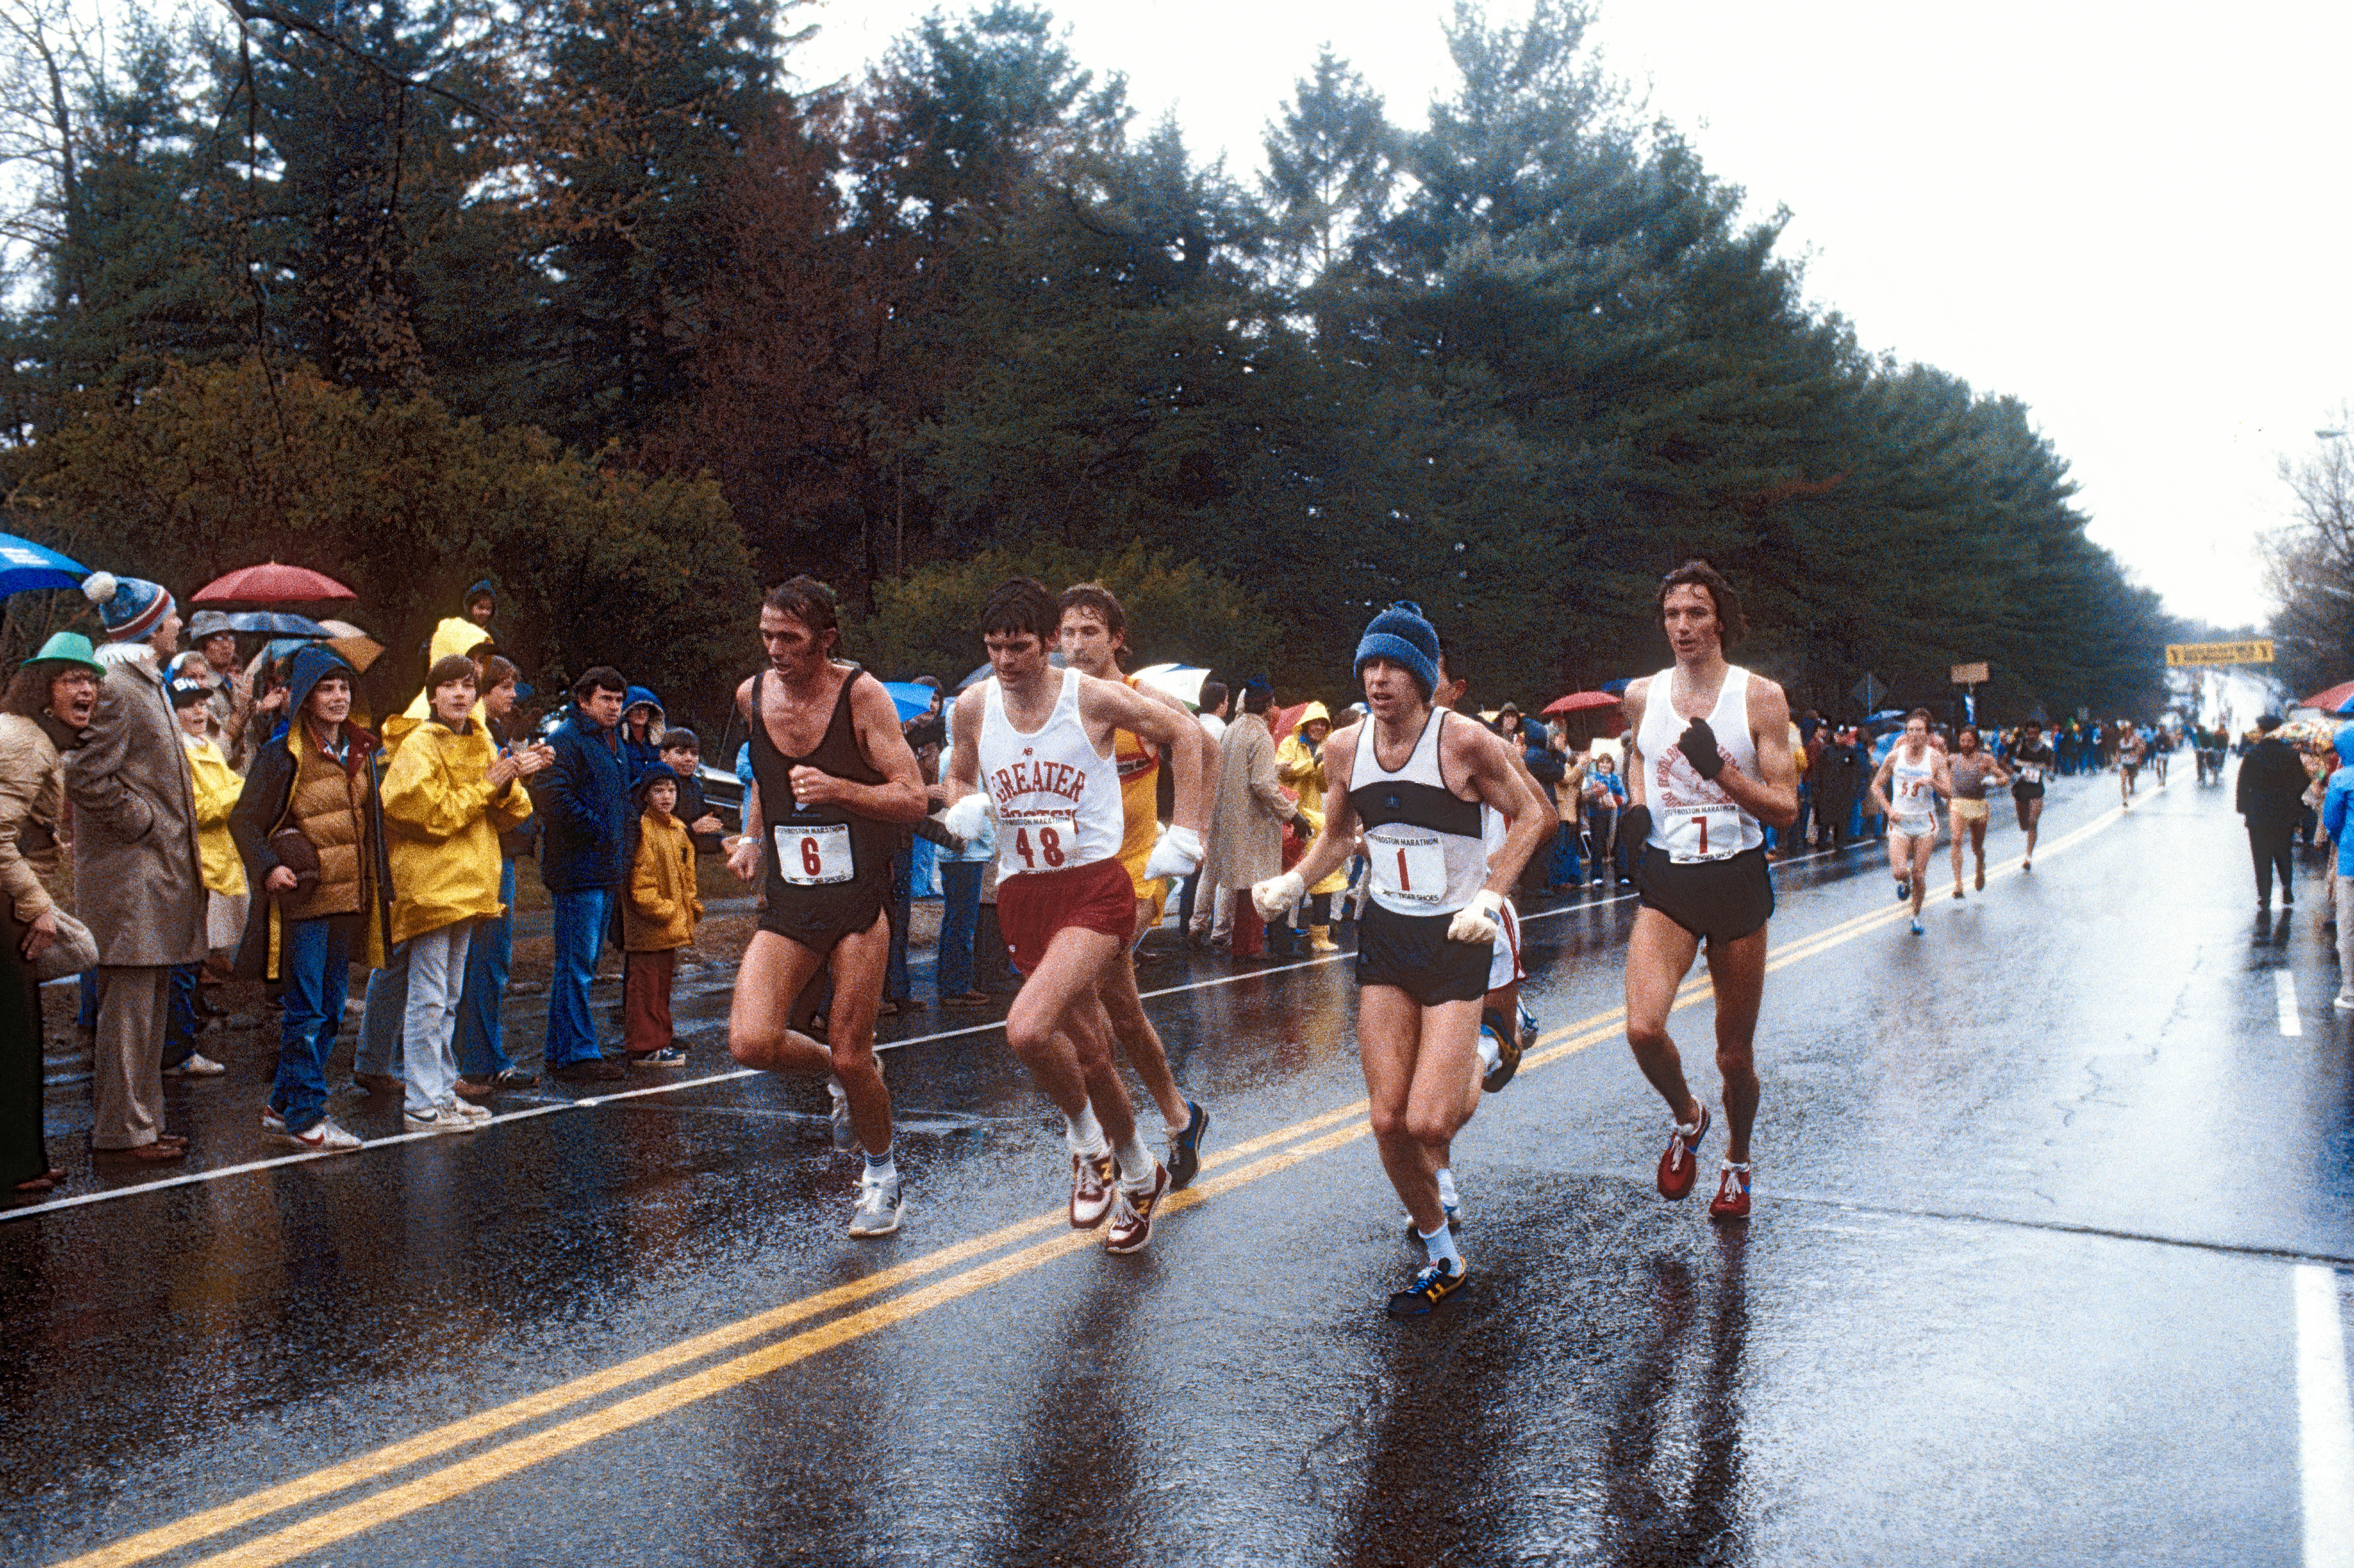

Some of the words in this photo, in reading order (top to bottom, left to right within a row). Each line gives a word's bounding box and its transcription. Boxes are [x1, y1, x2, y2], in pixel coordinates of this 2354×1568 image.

[1033, 817, 1070, 825] MARATHON
[1701, 805, 1736, 813] MARATHON
[811, 825, 845, 834] MARATHON
[1378, 836, 1399, 845] BOSTON
[1401, 838, 1438, 846] MARATHON
[1691, 816, 1707, 854] 7
[800, 837, 821, 875] 6
[1016, 827, 1065, 868] 48
[1397, 847, 1410, 891] 1
